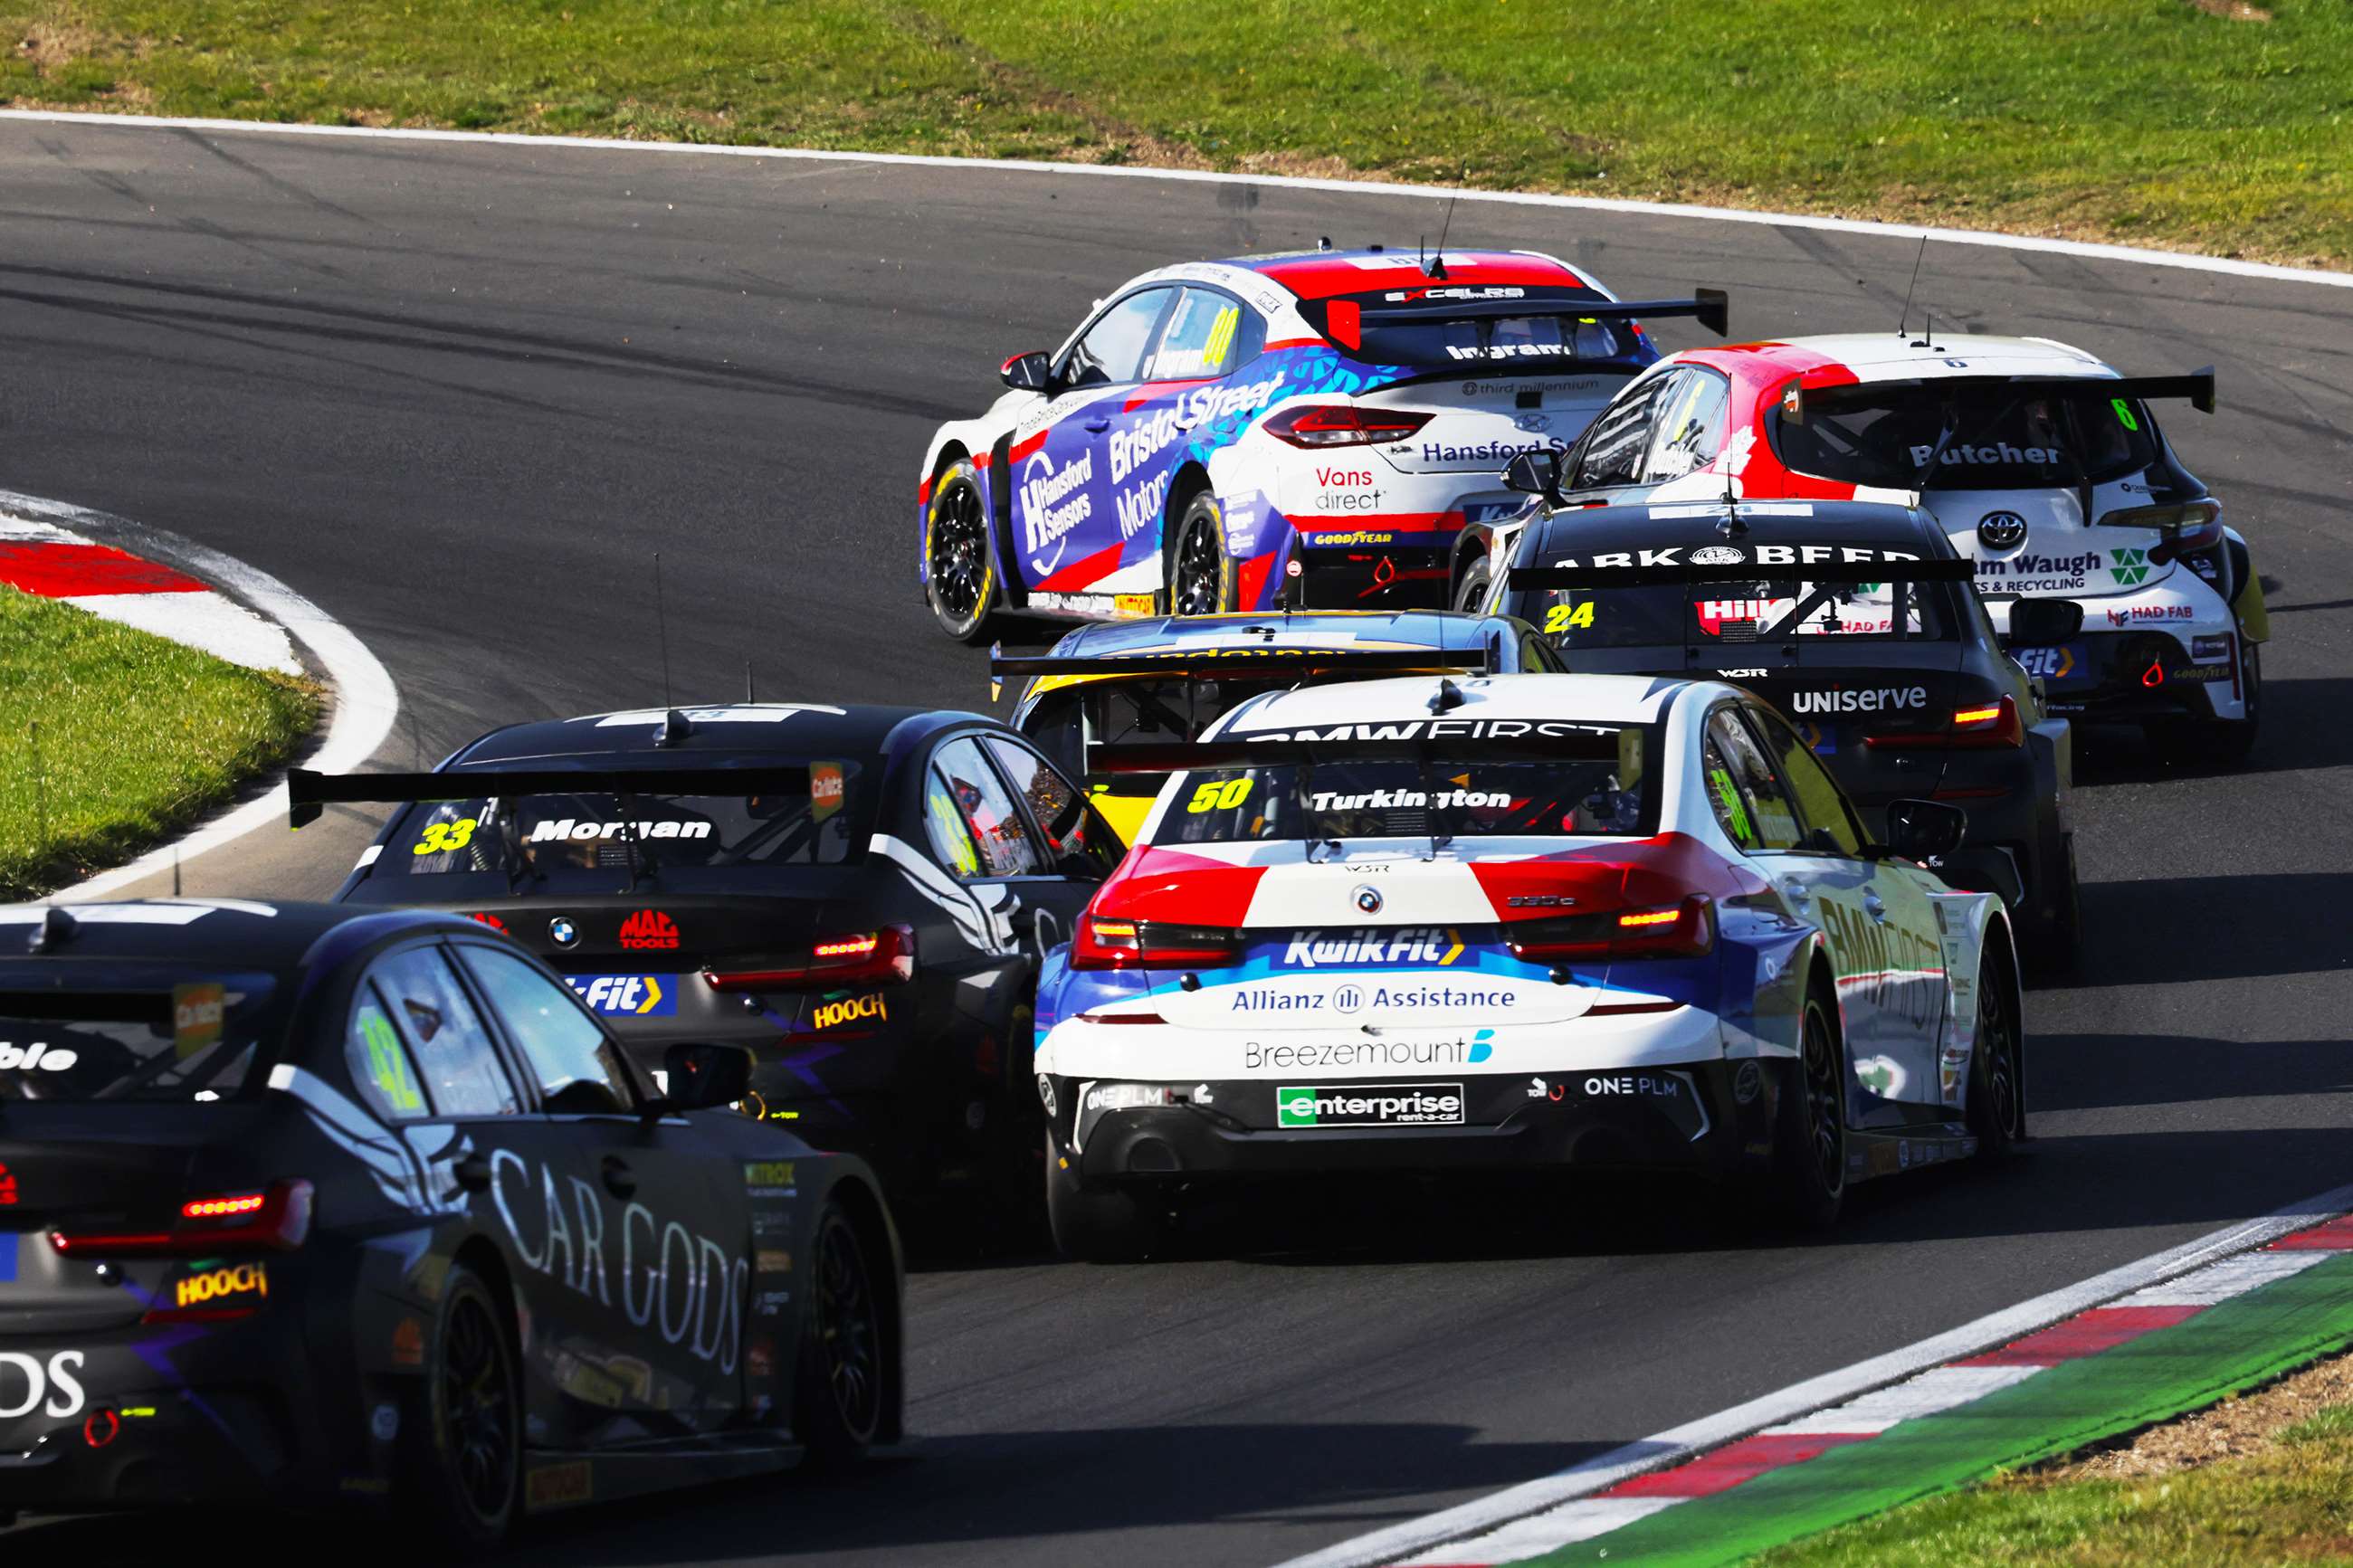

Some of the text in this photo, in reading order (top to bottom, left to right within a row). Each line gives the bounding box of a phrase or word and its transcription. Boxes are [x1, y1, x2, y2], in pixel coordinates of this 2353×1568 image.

[1187, 370, 1284, 426] Street
[1480, 378, 1599, 394] third millennium
[1909, 442, 2059, 468] Butcher
[1038, 449, 1092, 509] Hansford
[1316, 467, 1373, 487] Vans
[1315, 489, 1381, 509] direct
[1043, 492, 1091, 540] Sensors
[1314, 531, 1392, 546] GOODYEAR
[2012, 552, 2101, 576] Waugh
[2006, 577, 2085, 592] RECYCLING
[1544, 602, 1594, 632] 24
[2132, 606, 2193, 619] HAD FAB
[1717, 668, 1767, 678] WSR
[1186, 778, 1253, 813] 50
[413, 819, 476, 855] 33
[621, 938, 679, 949] TOOLS
[814, 992, 886, 1029] HOOCH
[1232, 987, 1515, 1011] Allianz Assistance
[1246, 1037, 1465, 1068] Breezemount
[1119, 1088, 1163, 1105] PLM
[1585, 1078, 1677, 1096] ONE PLM
[1290, 1091, 1461, 1120] enterprise
[1396, 1113, 1459, 1122] rent-a-car
[490, 1148, 748, 1375] CAR GODS
[176, 1261, 267, 1307] HOOCH
